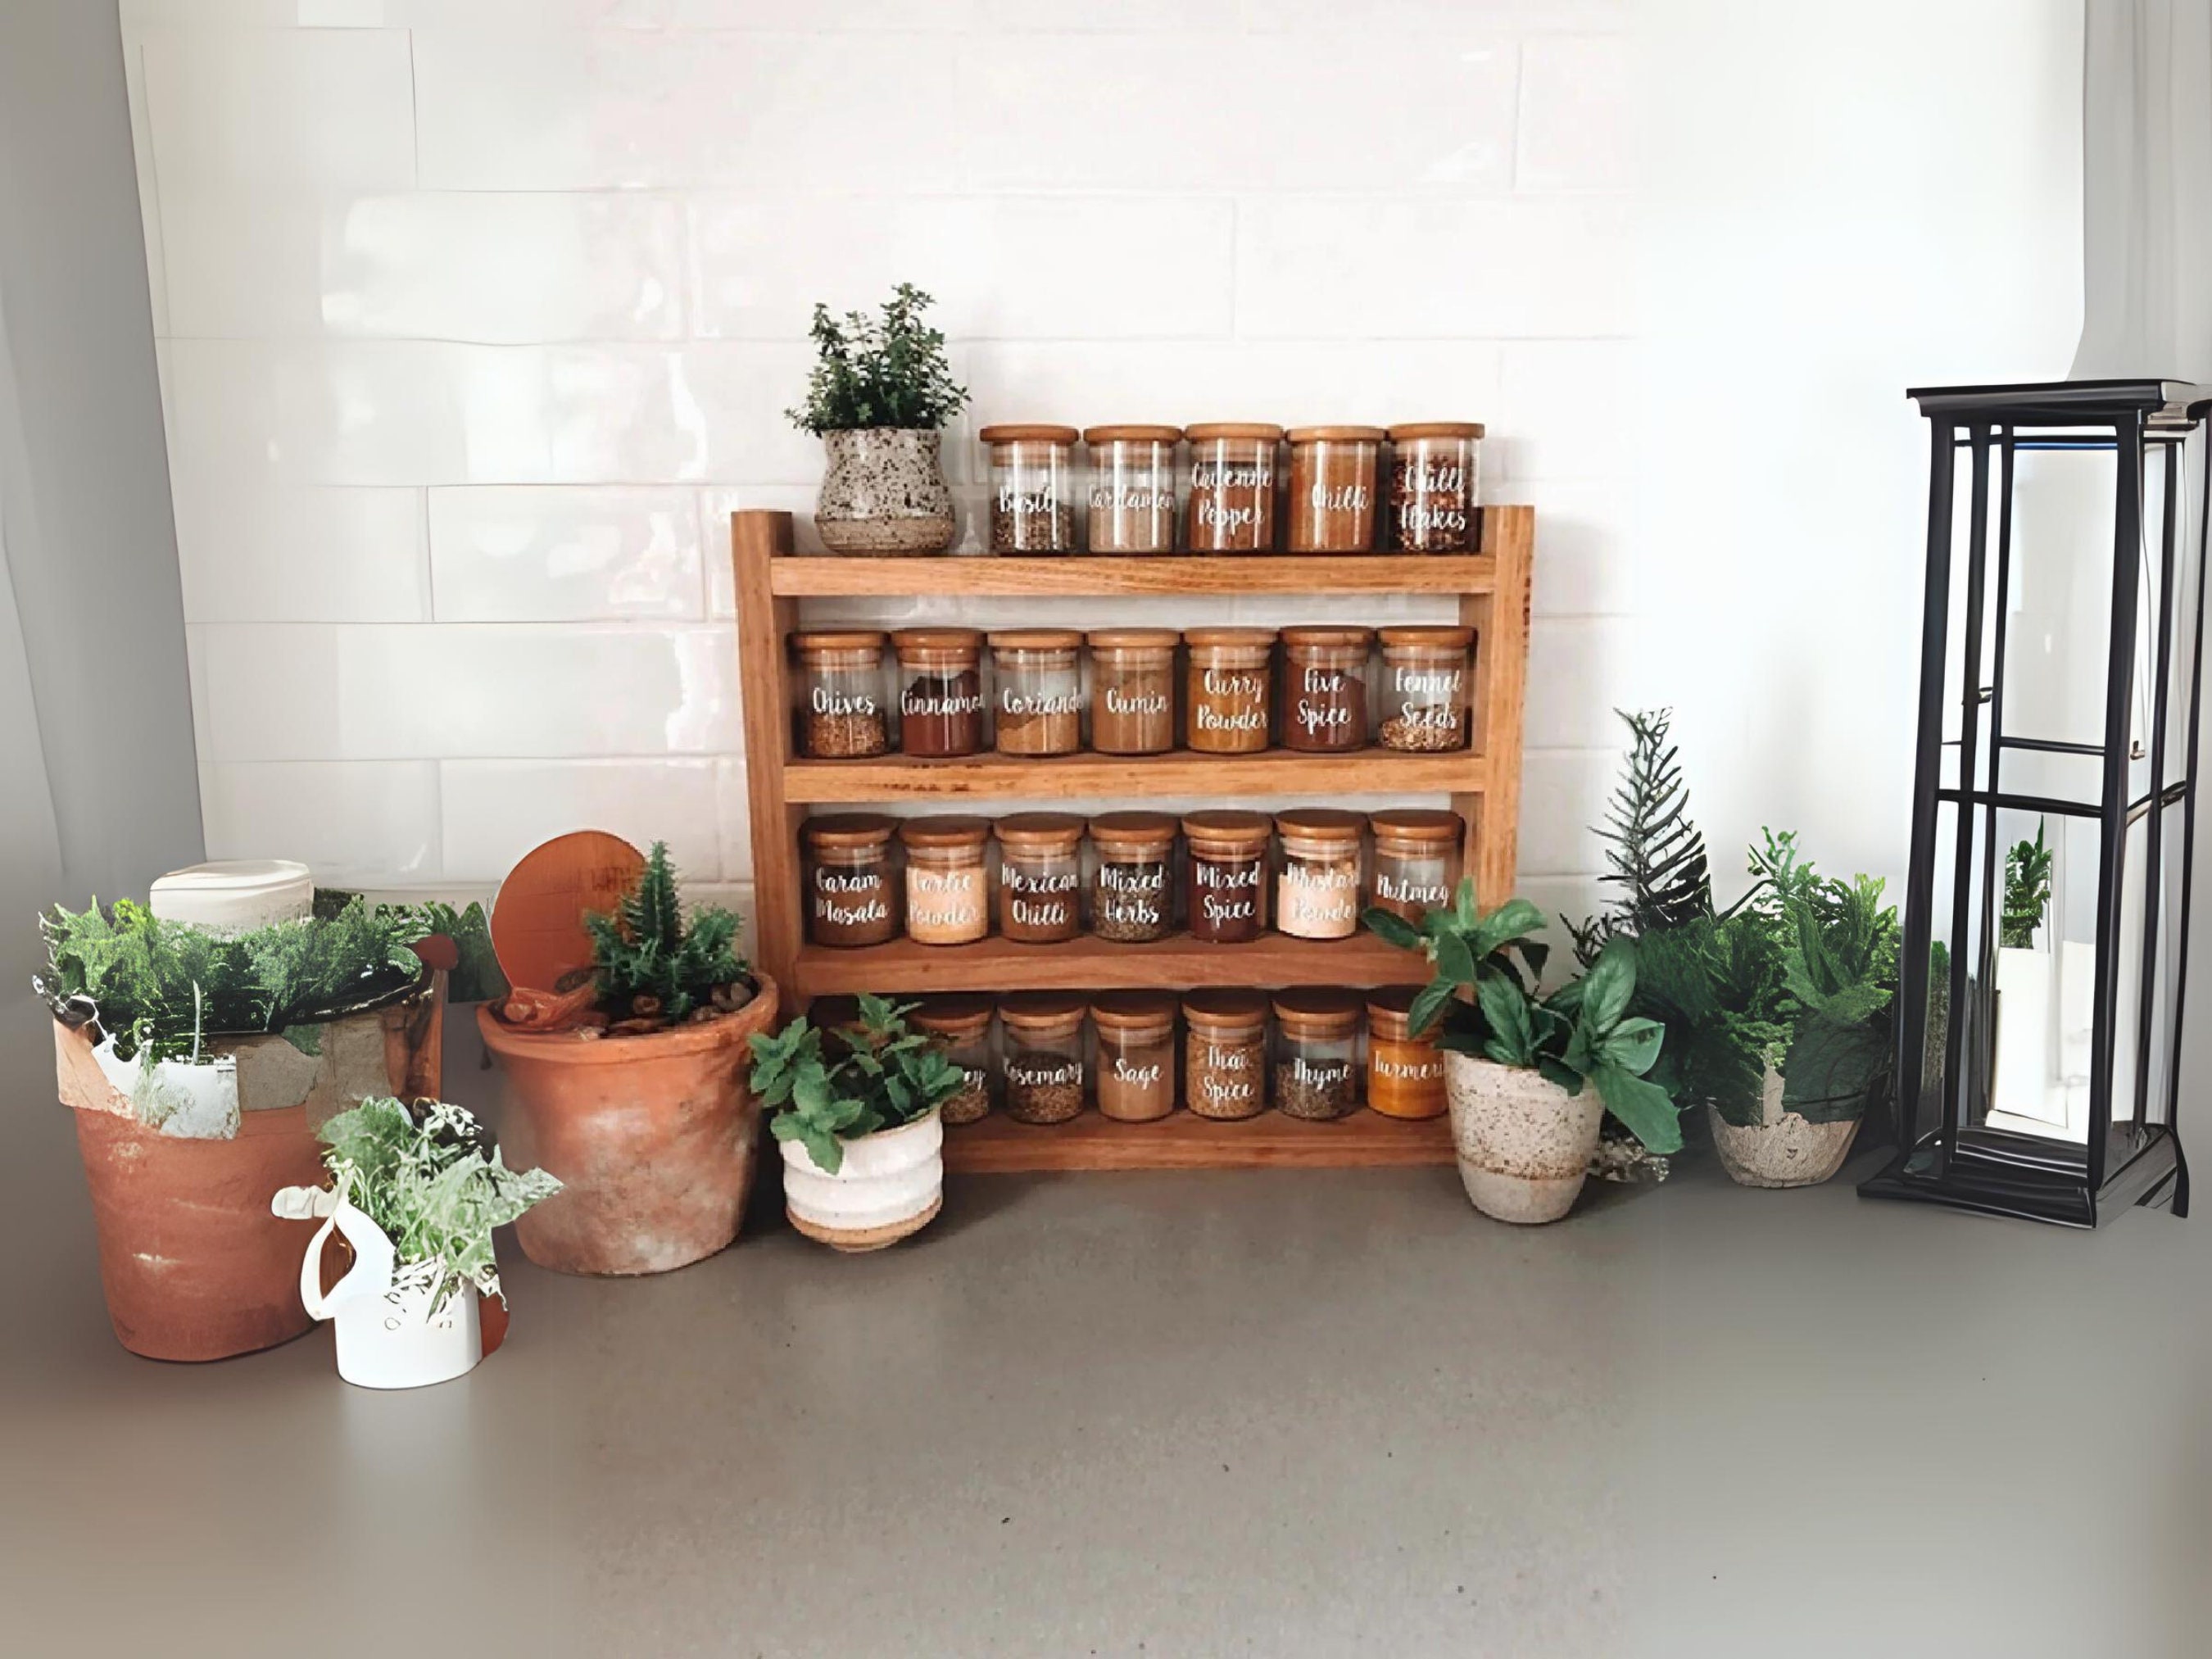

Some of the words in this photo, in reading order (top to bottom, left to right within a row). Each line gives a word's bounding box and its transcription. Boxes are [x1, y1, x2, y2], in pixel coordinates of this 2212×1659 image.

[1312, 483, 1369, 511] Chilli
[1199, 498, 1266, 536] Pepper
[1401, 502, 1466, 531] Flakes
[1204, 669, 1262, 703] Curry
[1303, 667, 1345, 694] Five
[1395, 666, 1462, 693] Fennel
[813, 687, 876, 716] Chives
[1106, 687, 1168, 715] Cumin
[1401, 700, 1457, 729] Seeds
[1197, 703, 1267, 730] Powder
[1297, 699, 1351, 735] Spice
[816, 867, 882, 893] Garam
[1001, 863, 1078, 894] Mexican
[1100, 863, 1164, 893] Mixed
[1196, 861, 1261, 889] Mixed
[1377, 873, 1449, 909] Nutmeg
[815, 898, 890, 925] Masala
[1012, 900, 1068, 926] Chilli
[1105, 899, 1160, 924] Herbs
[1203, 894, 1256, 929] Spice
[1208, 1045, 1251, 1071] Thai
[1113, 1057, 1163, 1090] Sage
[1294, 1057, 1351, 1090] Thyme
[1203, 1075, 1253, 1107] Spice
